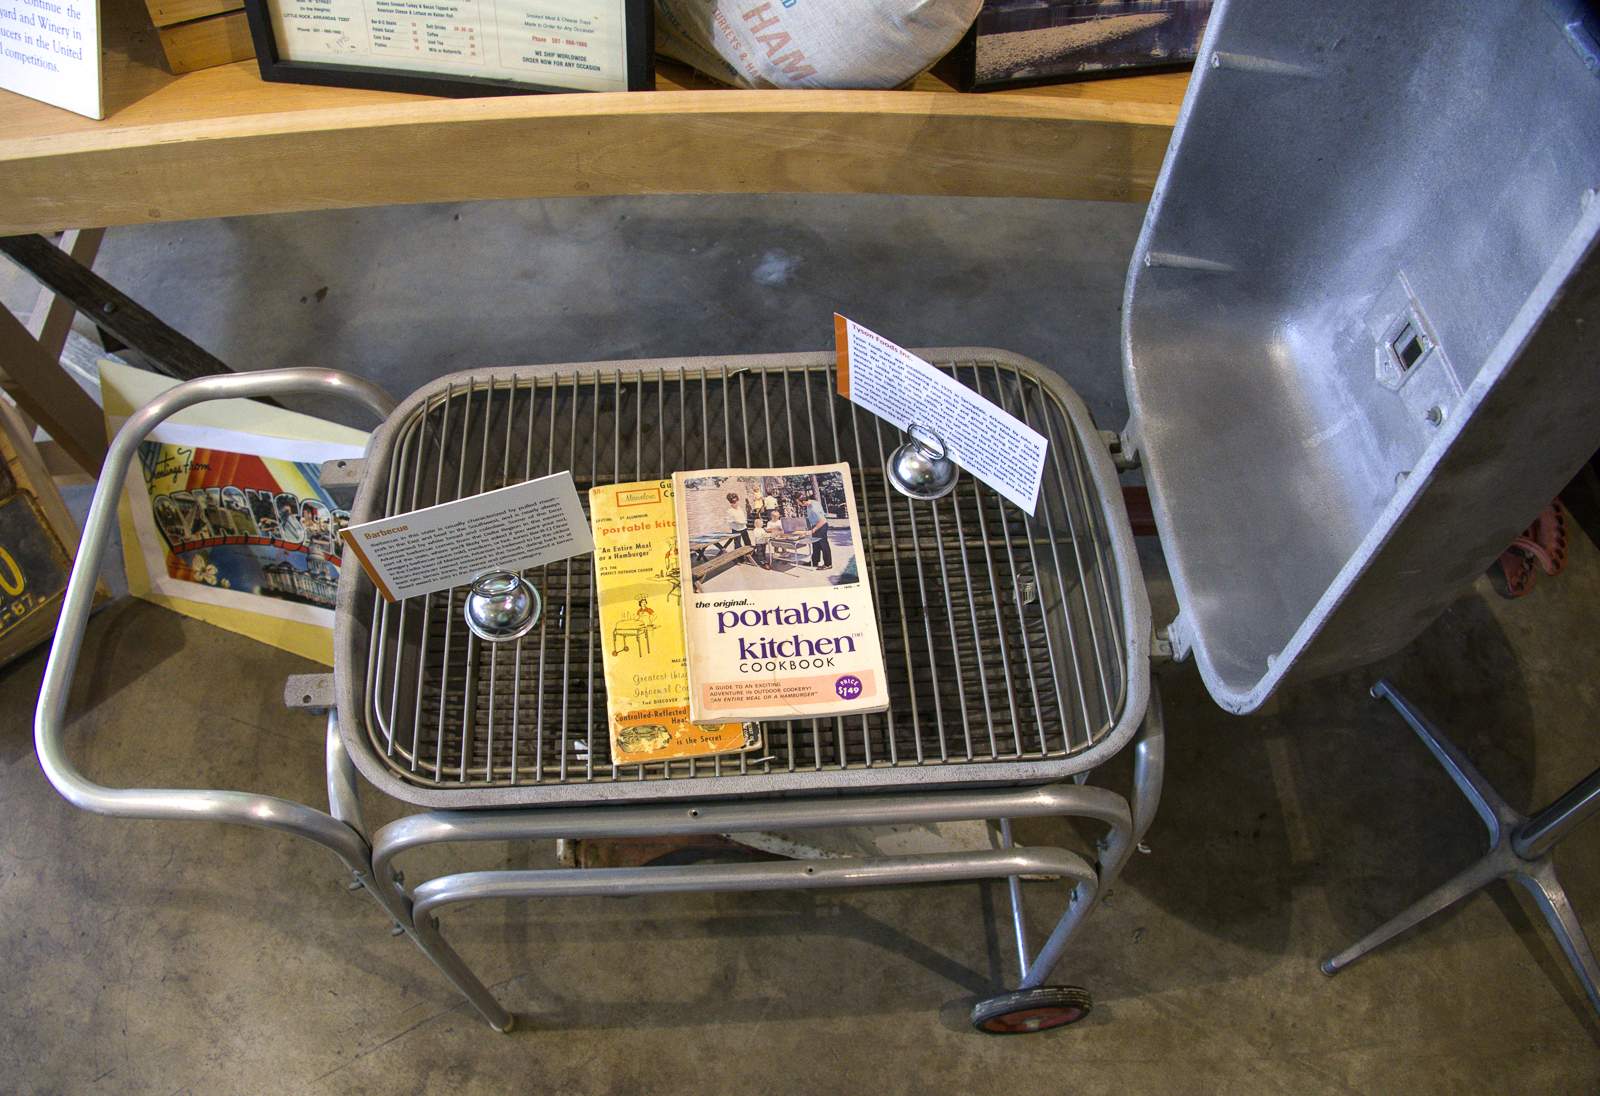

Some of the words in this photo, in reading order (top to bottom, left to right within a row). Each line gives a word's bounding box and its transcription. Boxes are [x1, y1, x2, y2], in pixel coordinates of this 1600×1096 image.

[66, 4, 80, 20] the
[20, 13, 35, 26] and
[38, 15, 69, 40] Winery
[73, 28, 82, 40] in
[24, 32, 33, 45] in
[36, 34, 50, 50] the
[53, 40, 82, 60] United
[742, 2, 817, 81] HAM
[4, 48, 60, 72] competitions.
[557, 53, 587, 62] WORLDWIDE
[576, 63, 600, 71] OCCASION
[852, 324, 874, 339] Tyson
[876, 336, 898, 352] Foods
[853, 333, 865, 344] Tyson
[905, 362, 932, 382] established
[989, 414, 1010, 432] Arkansas
[365, 525, 408, 539] Barbecue
[714, 599, 755, 608] original...
[718, 600, 850, 633] portable
[738, 634, 856, 660] kitchen
[740, 657, 835, 673] COOKBOOK
[615, 708, 687, 722] Controlled-Reflected
[701, 735, 722, 743] Secret
